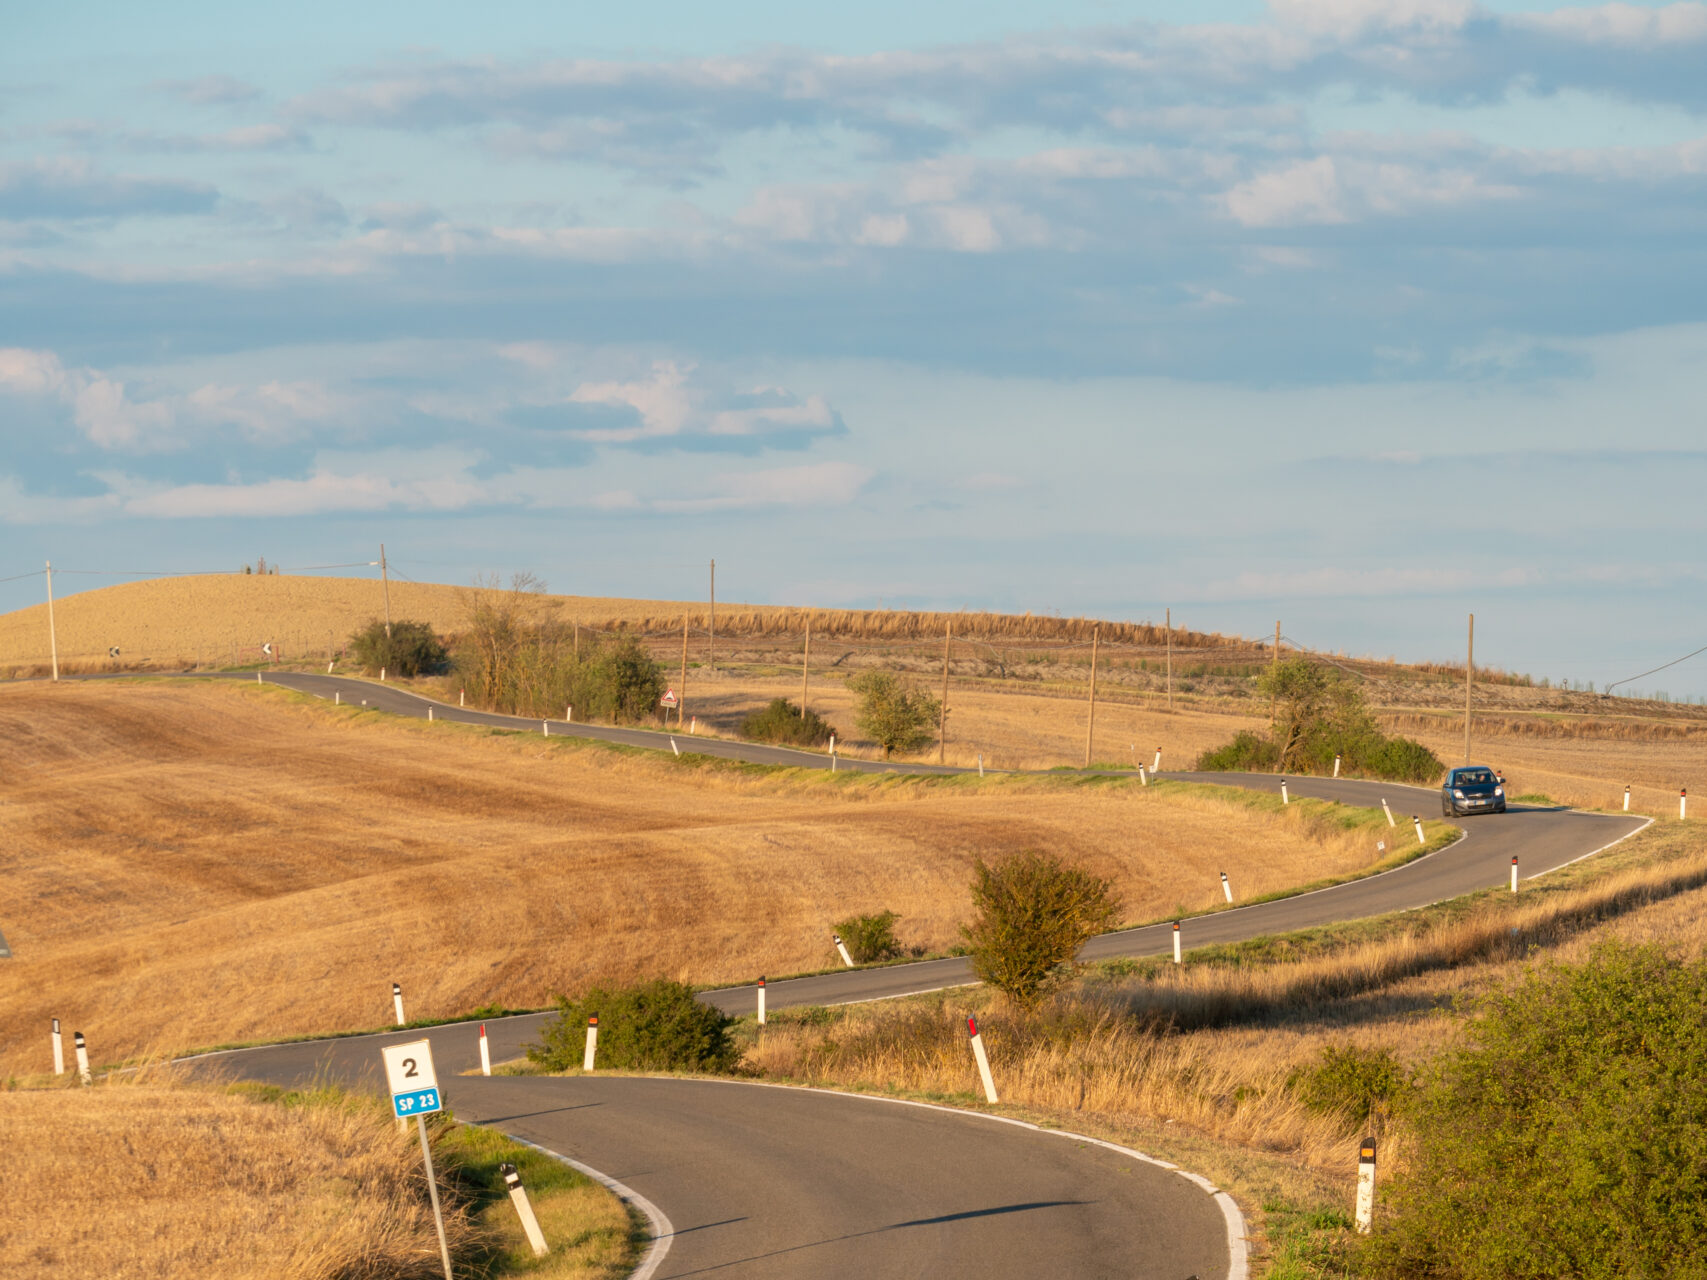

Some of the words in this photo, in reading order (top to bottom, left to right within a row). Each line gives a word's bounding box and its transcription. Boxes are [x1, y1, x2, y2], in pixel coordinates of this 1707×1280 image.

[402, 1058, 418, 1078] 2
[399, 1097, 414, 1111] SP
[419, 1093, 435, 1107] 23
